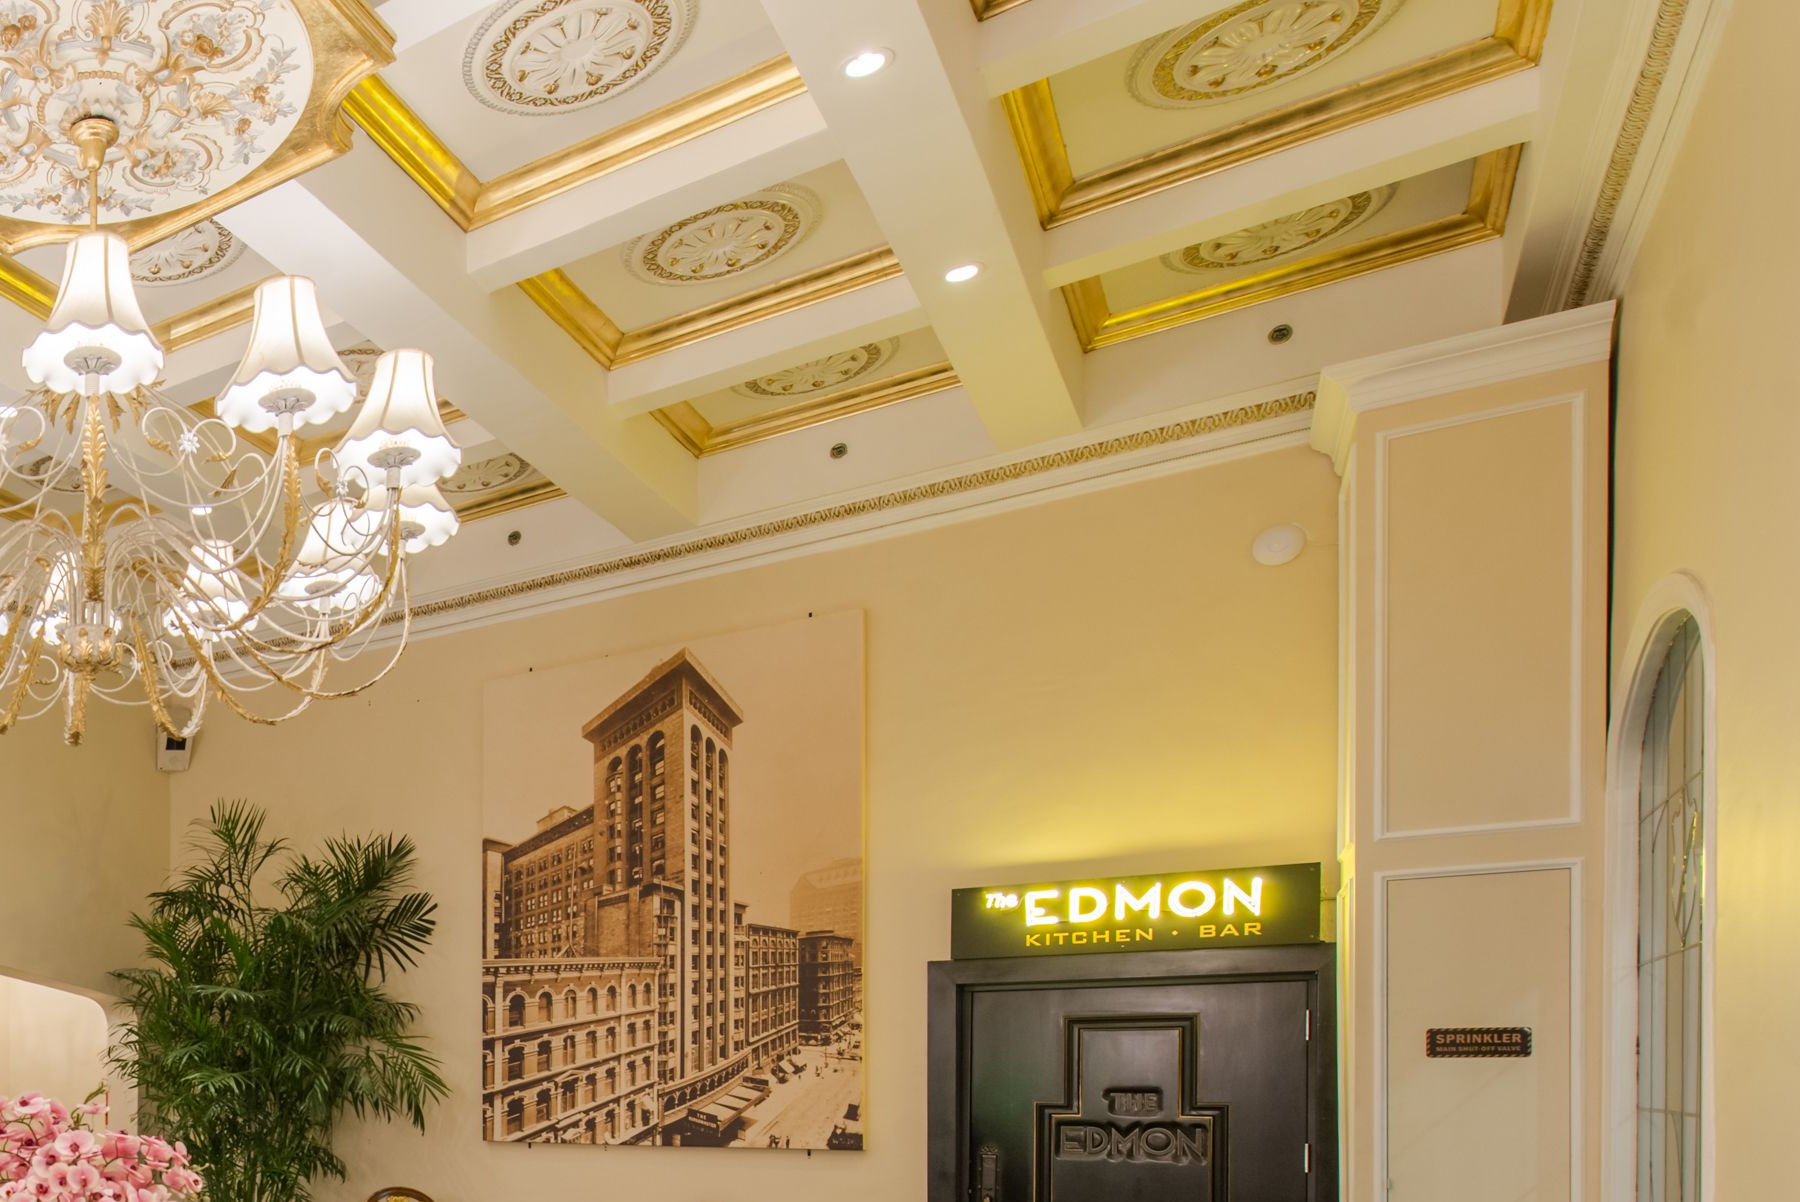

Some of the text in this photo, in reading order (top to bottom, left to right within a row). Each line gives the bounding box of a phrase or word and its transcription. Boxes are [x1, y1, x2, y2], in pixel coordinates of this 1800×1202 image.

[985, 877, 1263, 926] The EDMON
[1025, 922, 1262, 947] KITCHEN BAR
[1435, 1033, 1522, 1044] SPRINKLER
[1110, 1092, 1159, 1113] THE
[1060, 1125, 1204, 1158] EDMON
